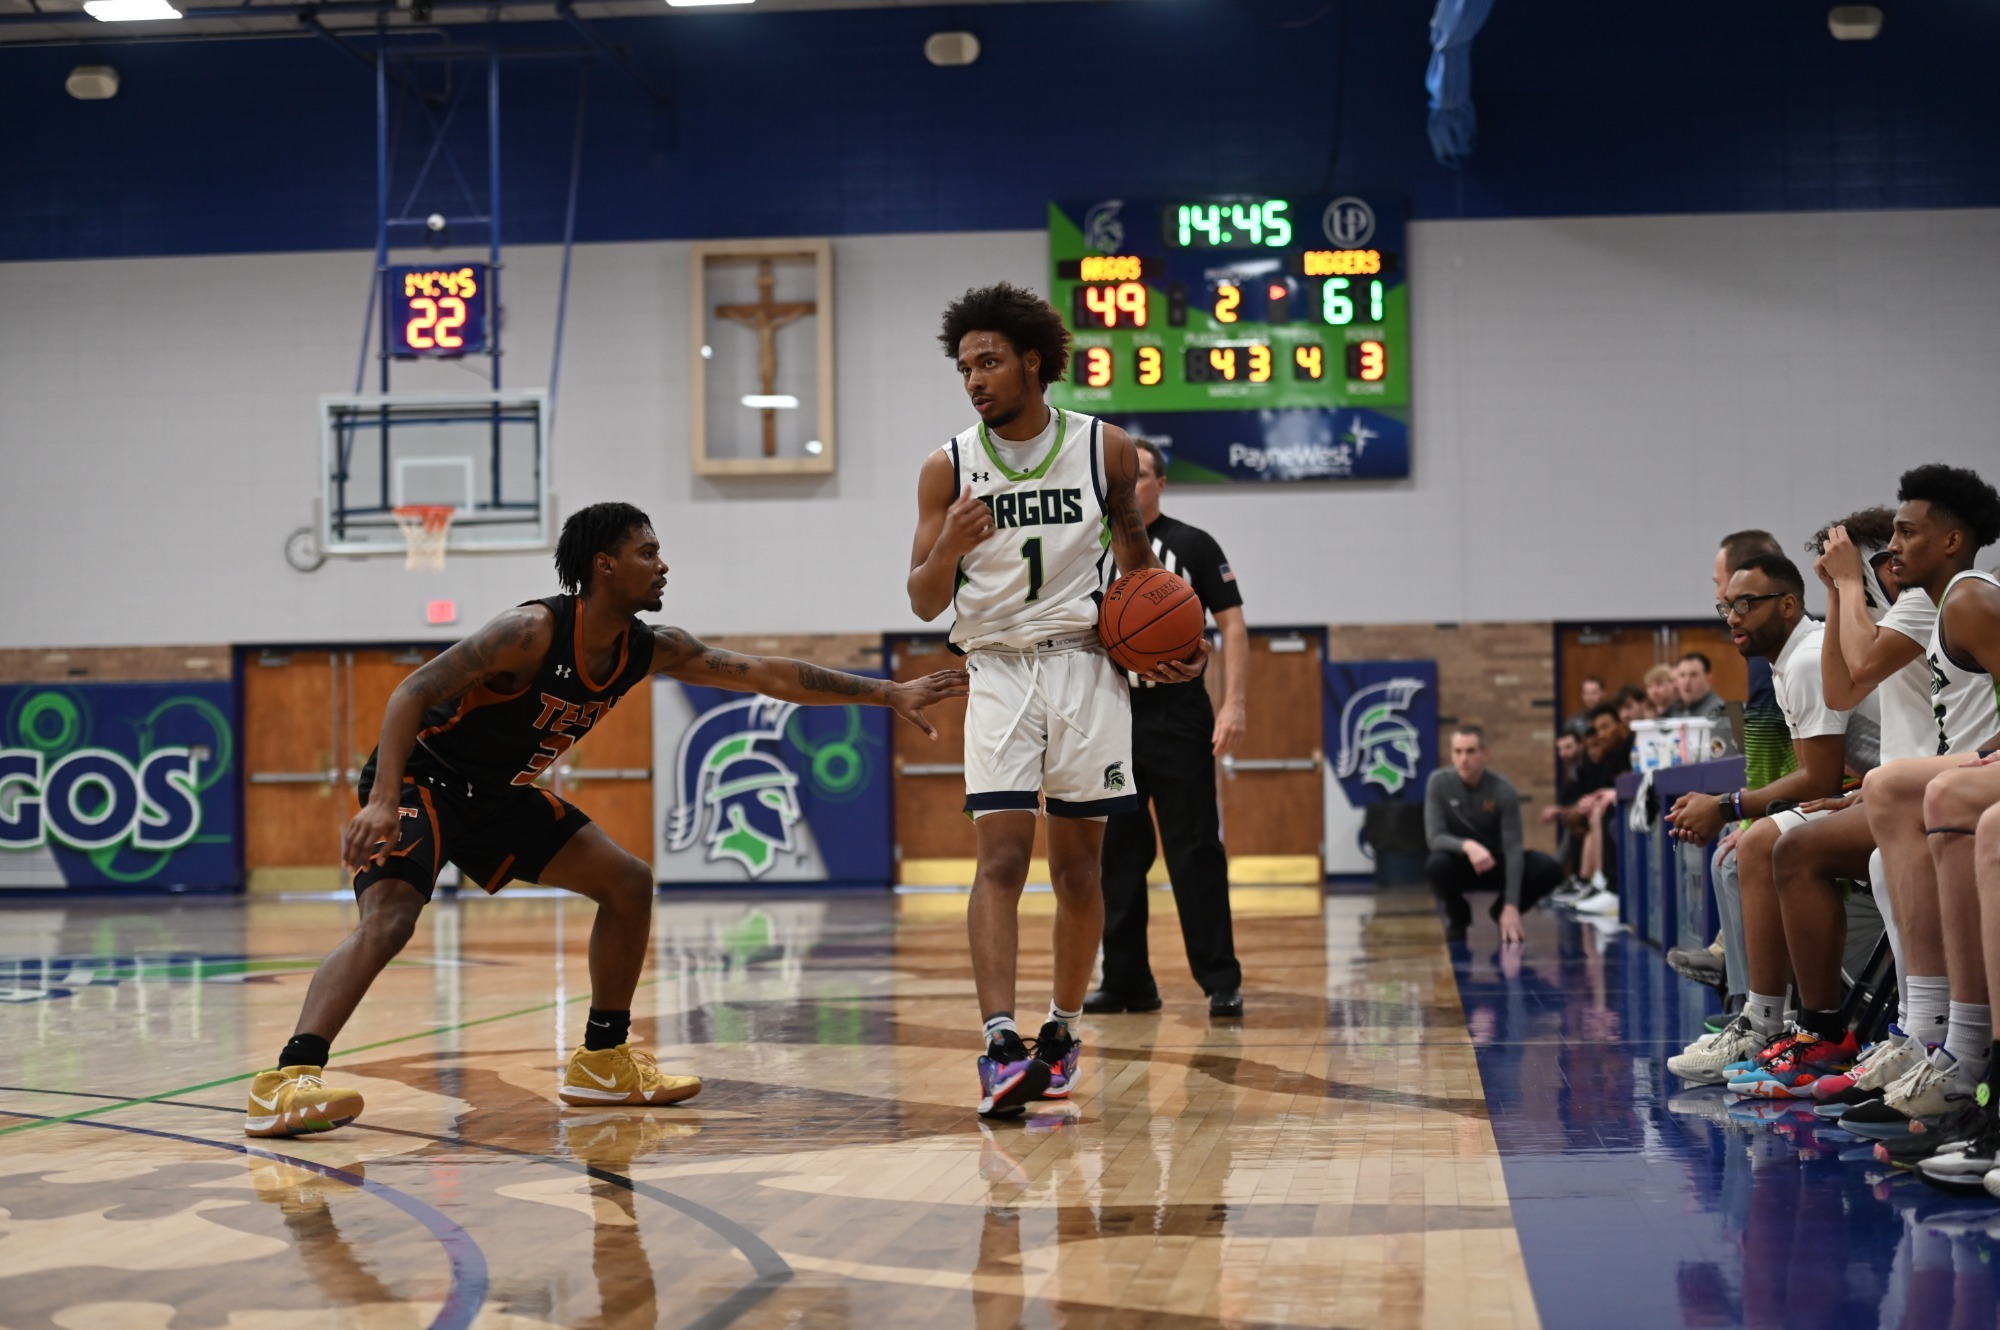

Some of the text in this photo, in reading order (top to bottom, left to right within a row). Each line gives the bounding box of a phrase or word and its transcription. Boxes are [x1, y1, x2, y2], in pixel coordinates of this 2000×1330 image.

[1179, 200, 1292, 246] 14:45
[405, 268, 477, 298] 14:45
[1323, 277, 1383, 325] 61
[406, 297, 466, 348] 22
[1086, 282, 1146, 327] 49
[1215, 285, 1240, 322] 2
[1088, 347, 1111, 386] 3
[1139, 347, 1161, 385] 3
[1296, 346, 1321, 378] 4
[1360, 341, 1384, 380] 3
[1229, 442, 1353, 471] PayneWest
[1020, 536, 1043, 604] 1
[1142, 576, 1184, 606] NAIA
[1056, 636, 1083, 646] ARMOUR
